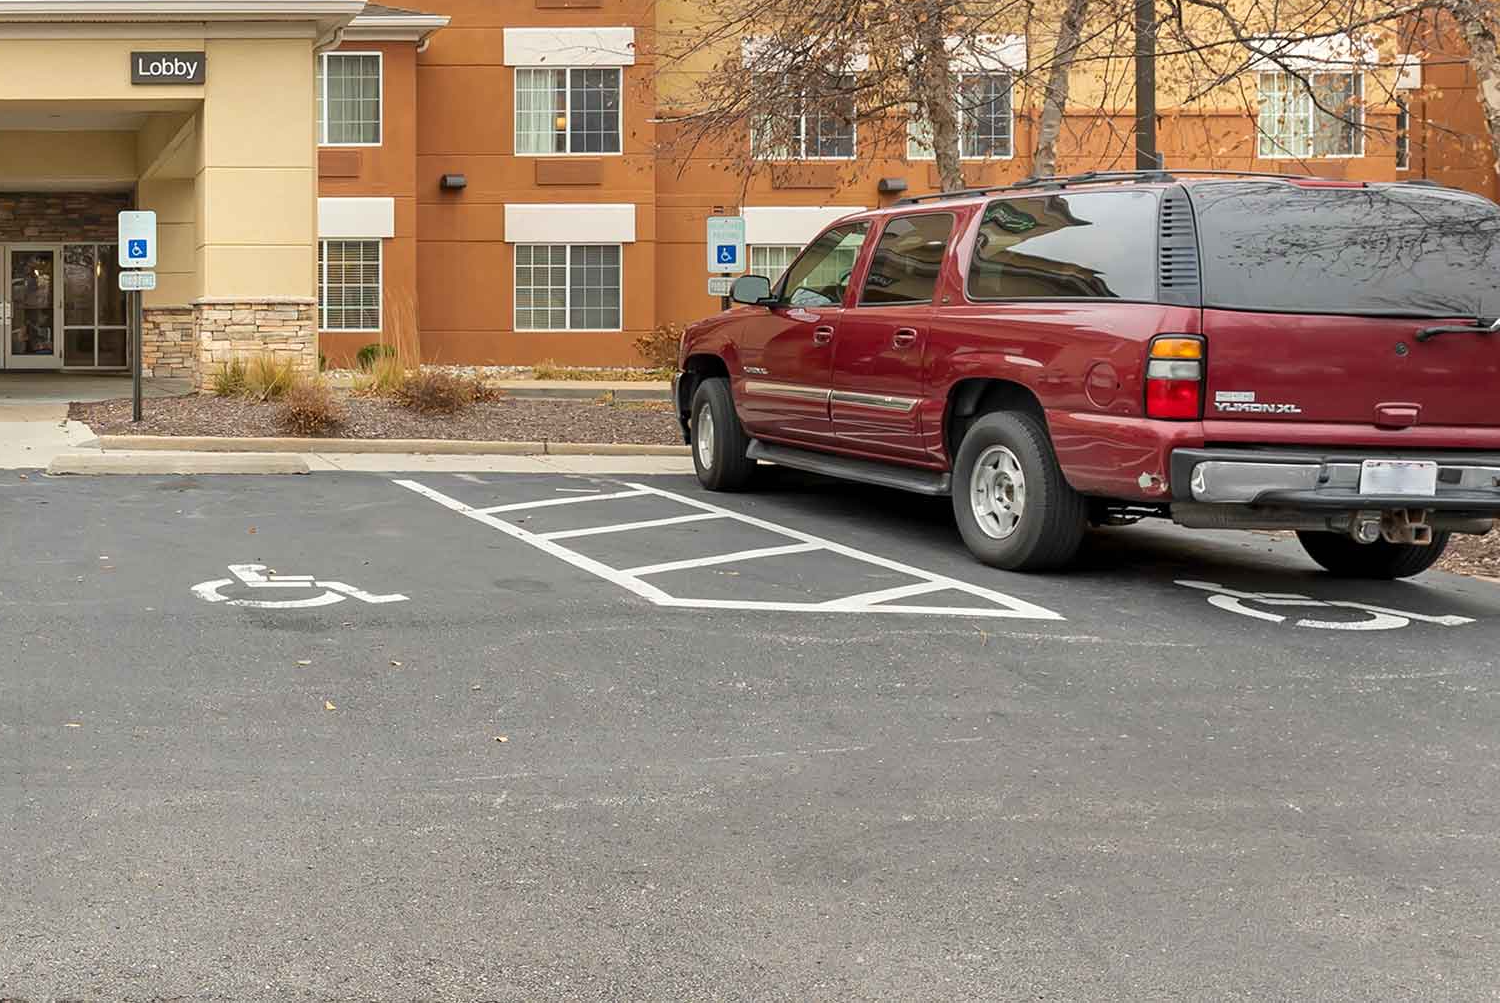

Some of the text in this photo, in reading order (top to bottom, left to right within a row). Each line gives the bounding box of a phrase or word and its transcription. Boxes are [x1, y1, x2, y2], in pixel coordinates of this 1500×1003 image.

[138, 57, 198, 79] Lobby
[1213, 402, 1302, 413] YUKON XL
